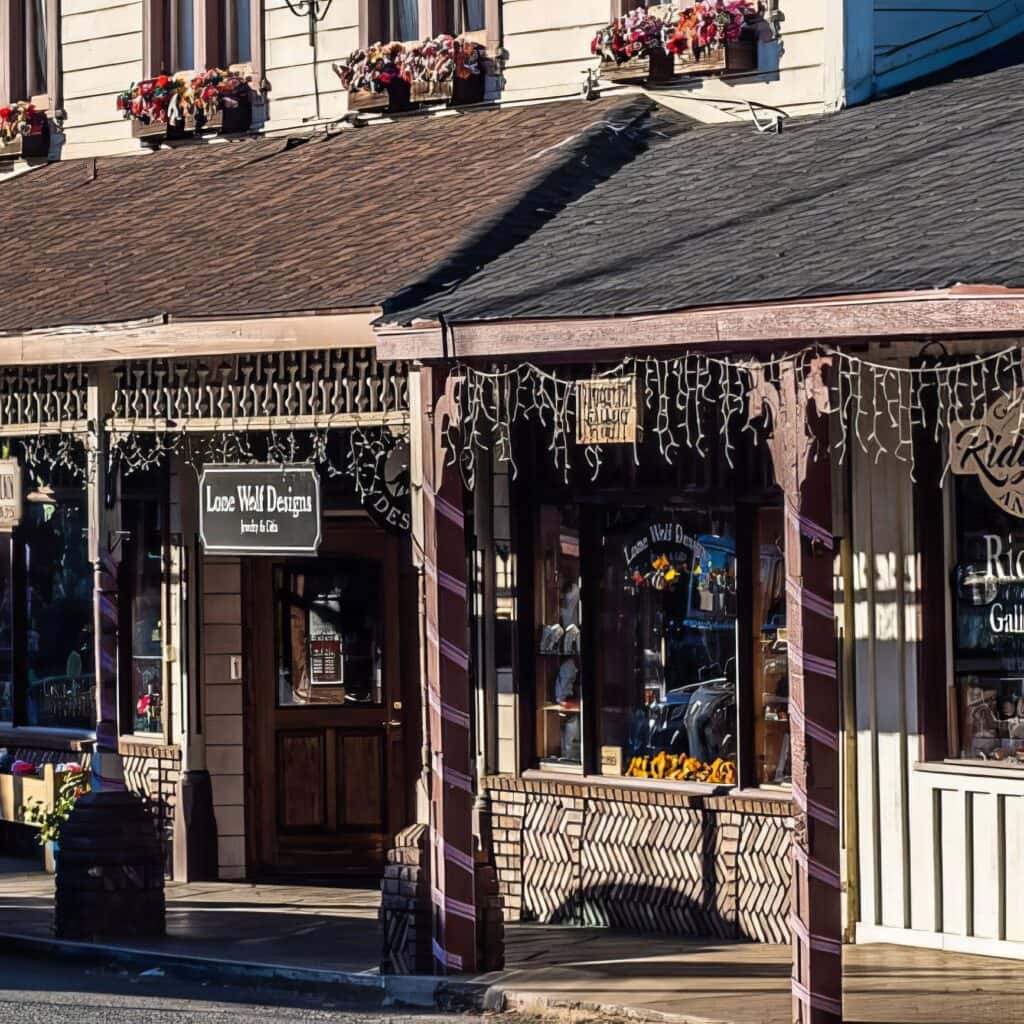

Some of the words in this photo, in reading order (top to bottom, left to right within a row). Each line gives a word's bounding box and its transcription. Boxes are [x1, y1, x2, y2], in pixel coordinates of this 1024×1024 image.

[956, 424, 1024, 487] Rid
[0, 473, 15, 500] INN
[206, 485, 236, 512] Lone
[237, 485, 265, 512] Wolf
[266, 485, 312, 518] Designs
